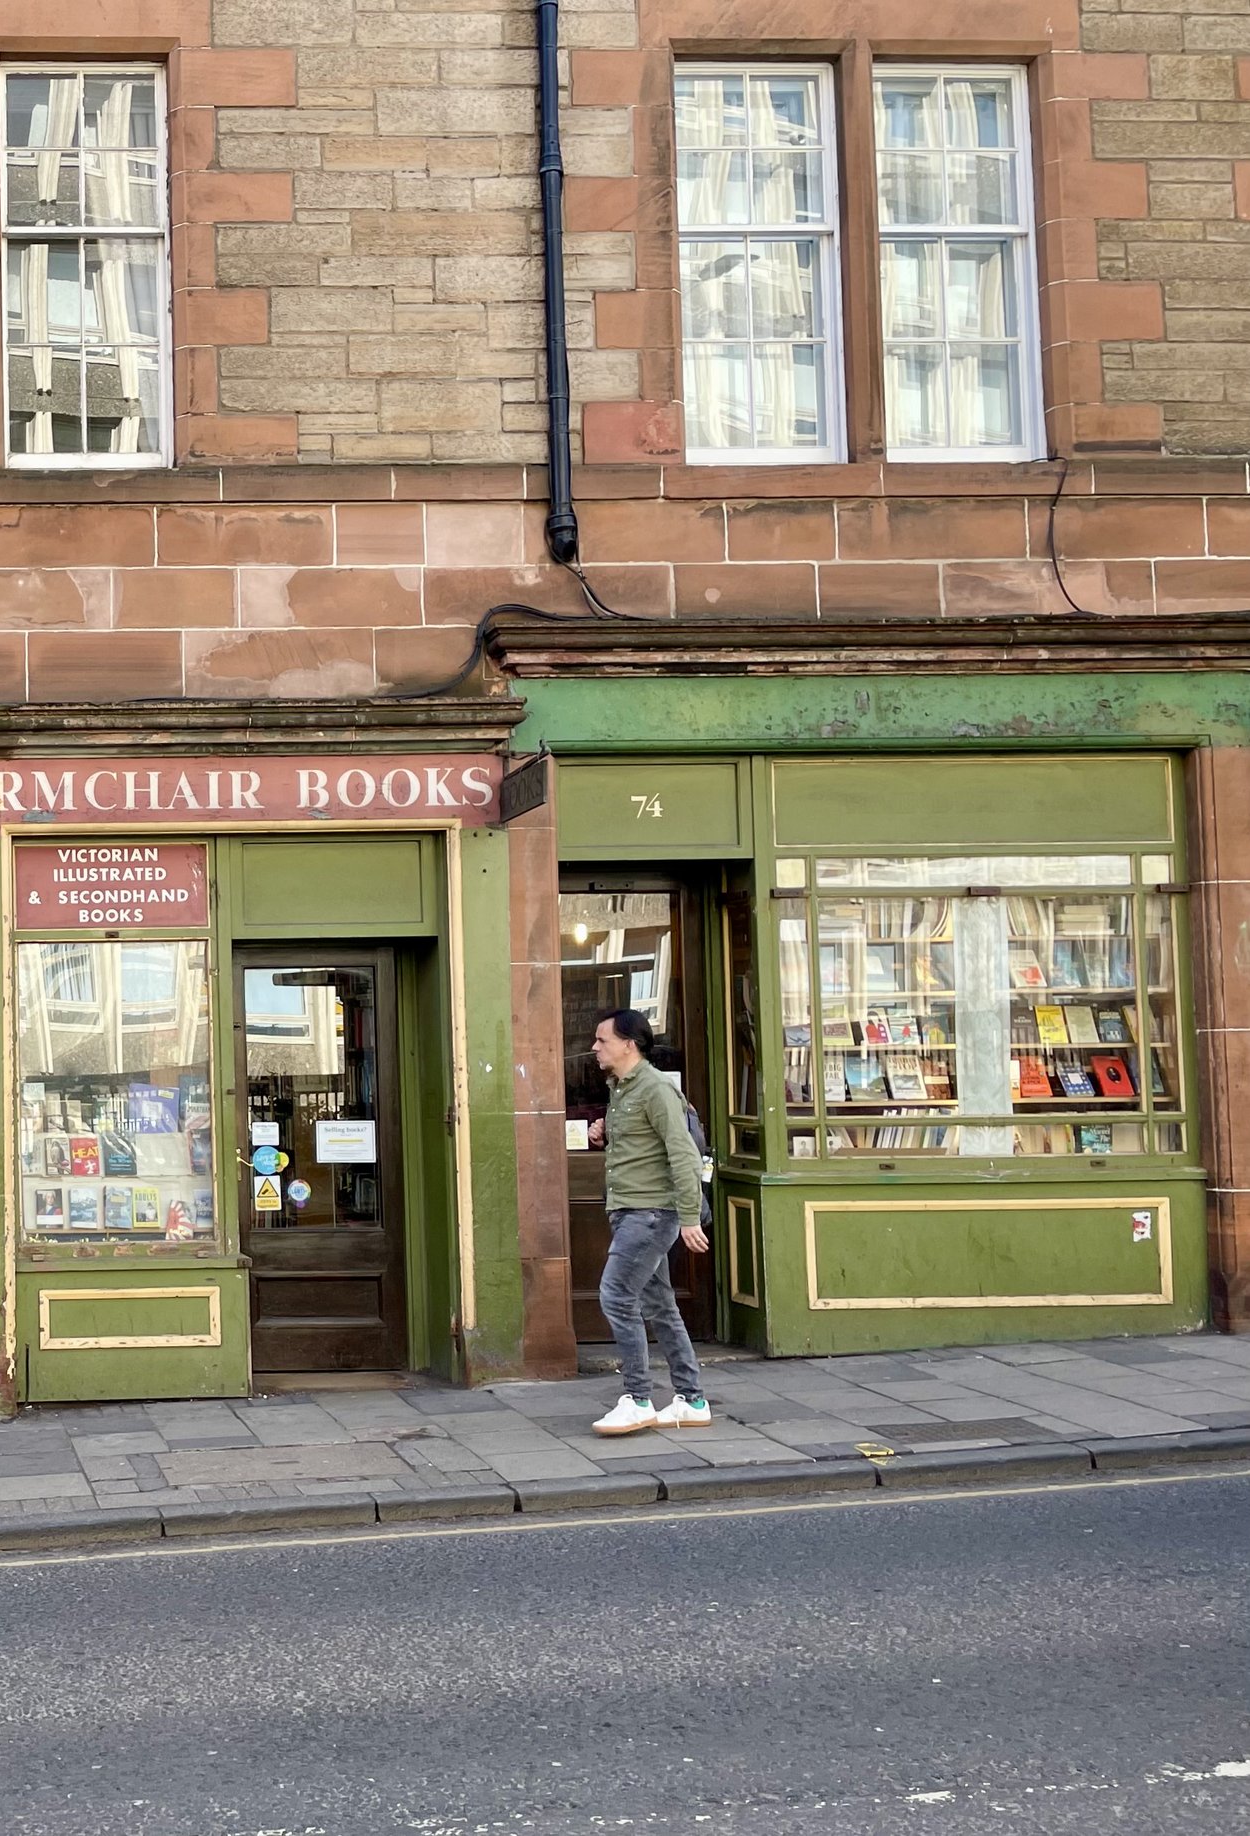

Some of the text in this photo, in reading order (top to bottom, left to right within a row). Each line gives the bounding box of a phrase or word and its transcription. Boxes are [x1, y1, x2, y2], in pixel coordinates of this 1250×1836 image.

[295, 766, 493, 808] BOOKS
[630, 792, 664, 819] 74
[57, 847, 159, 863] VICTORIAN
[53, 867, 167, 882] ILLUSTRATED
[28, 888, 190, 905] & SECONDHAND
[78, 908, 144, 923] BOOKS
[72, 1146, 98, 1159] HEAT
